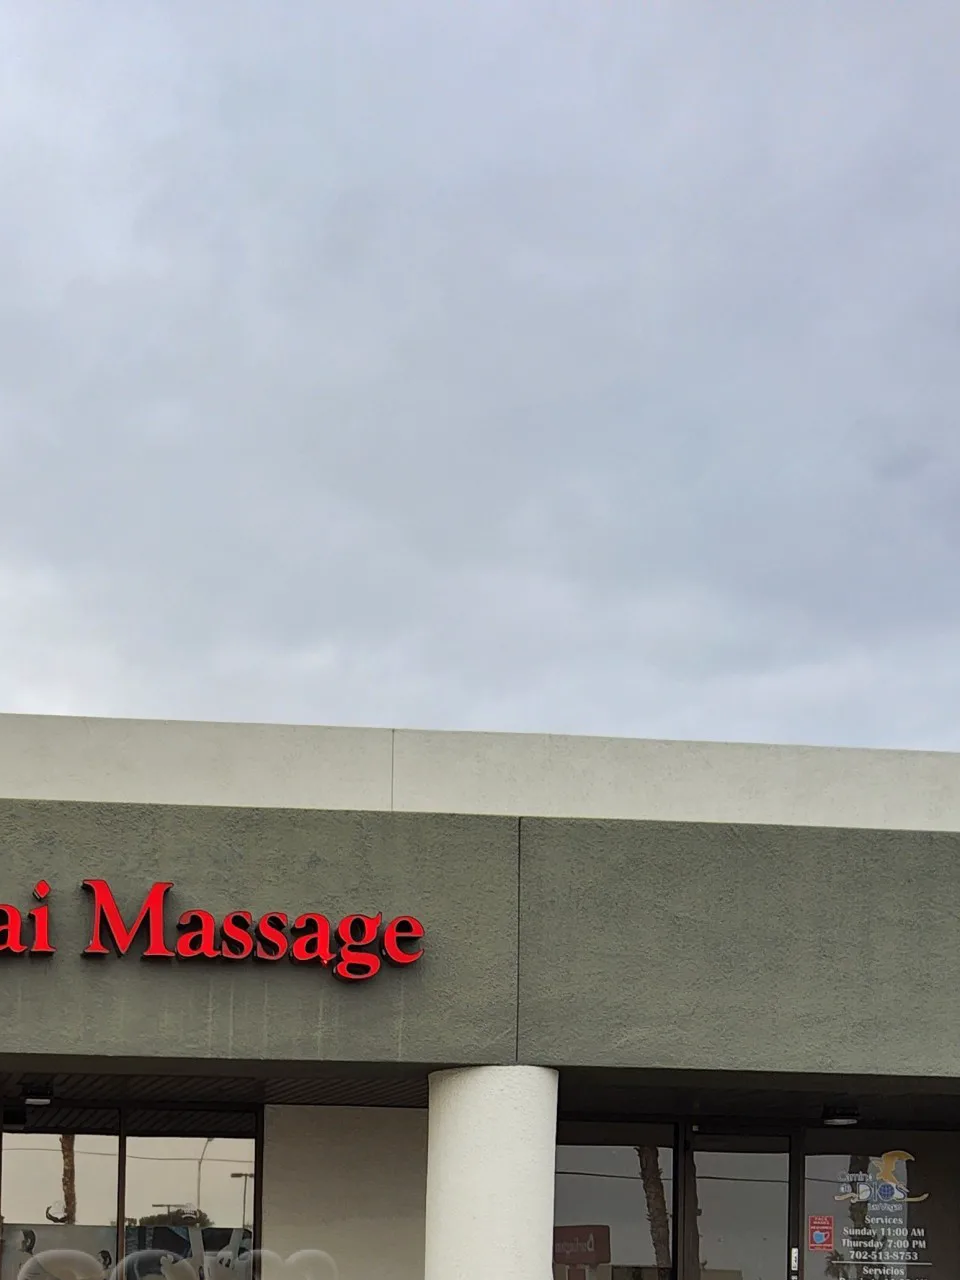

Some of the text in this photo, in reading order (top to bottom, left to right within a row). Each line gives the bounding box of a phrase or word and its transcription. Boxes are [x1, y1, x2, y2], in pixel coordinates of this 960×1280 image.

[83, 879, 425, 981] Massage
[864, 1215, 903, 1225] Services
[843, 1227, 925, 1238] Sunday 11:00 AM
[841, 1238, 885, 1249] Thursday
[887, 1239, 909, 1249] 7:00
[912, 1239, 926, 1249] PM
[849, 1251, 918, 1260] 702-513-8753
[862, 1266, 905, 1276] Servicios
